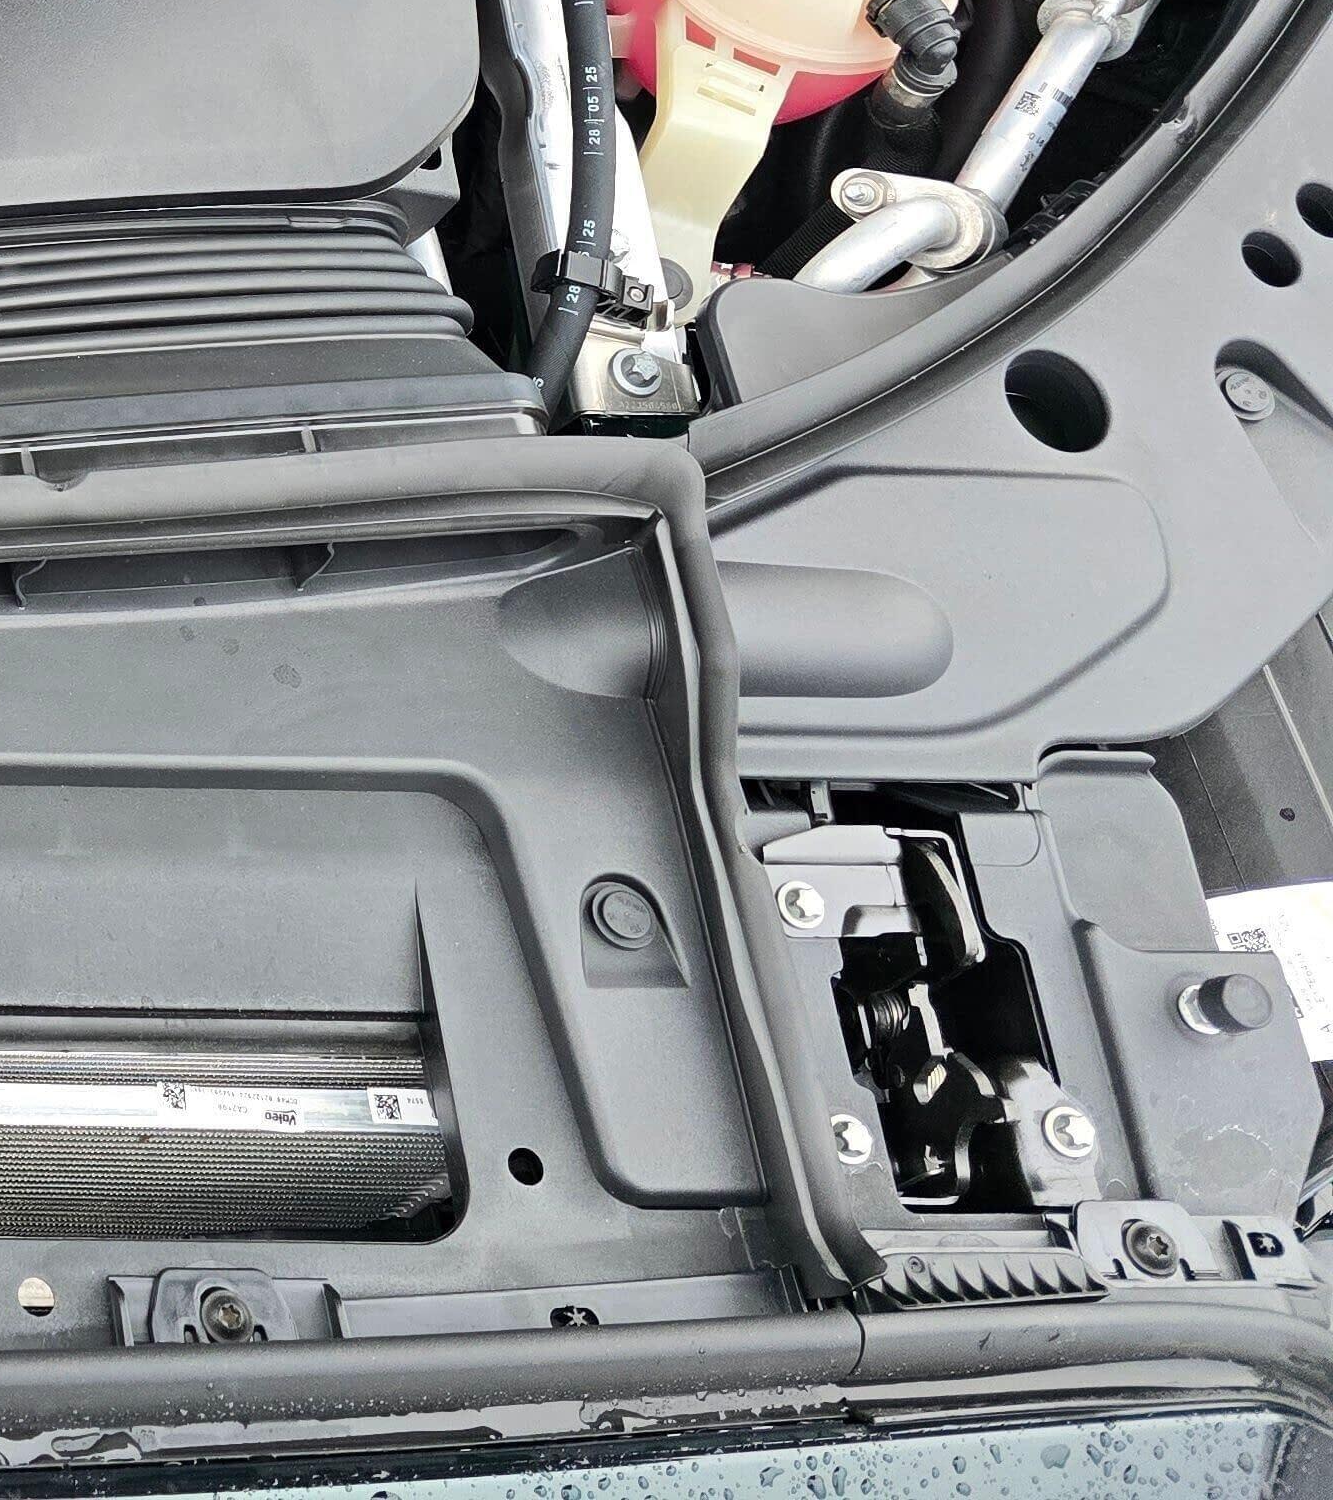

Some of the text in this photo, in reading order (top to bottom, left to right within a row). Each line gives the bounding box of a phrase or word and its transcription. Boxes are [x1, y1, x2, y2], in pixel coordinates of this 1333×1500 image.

[585, 65, 601, 145] 28 05 25
[565, 284, 582, 304] 28
[582, 219, 596, 238] 25
[264, 1110, 297, 1126] Valeo
